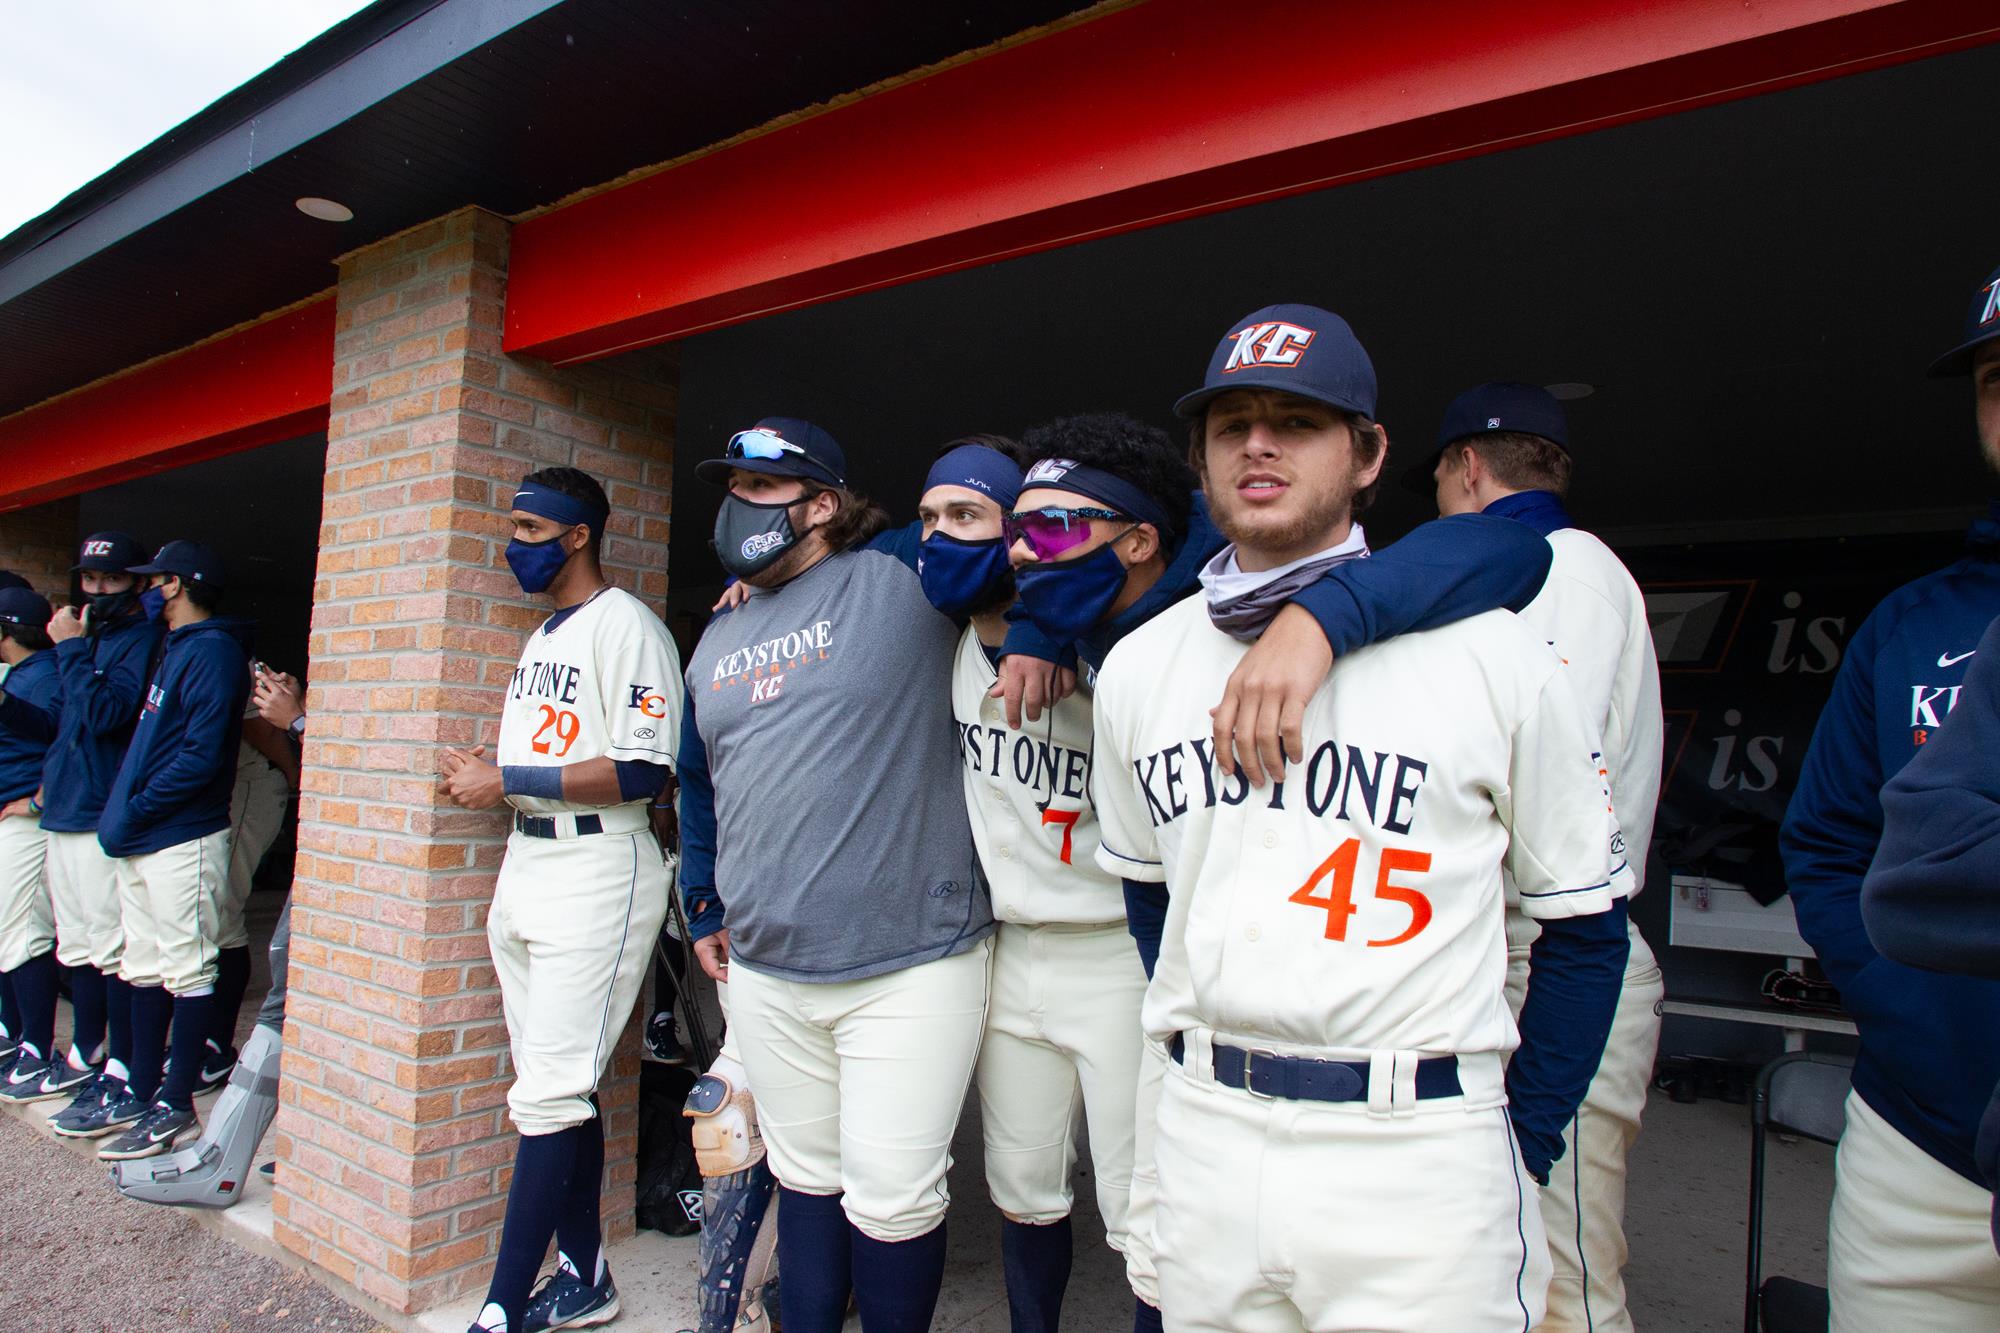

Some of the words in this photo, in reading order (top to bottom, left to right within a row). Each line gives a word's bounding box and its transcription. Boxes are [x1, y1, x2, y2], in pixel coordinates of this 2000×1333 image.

[1222, 321, 1317, 373] KC
[83, 541, 114, 556] KC
[712, 621, 832, 681] KEYSTONE
[1766, 591, 1846, 674] is
[628, 685, 666, 719] KC
[750, 673, 785, 703] KC
[531, 704, 581, 758] 29
[1707, 709, 1784, 791] is
[1042, 808, 1081, 865] 7
[1287, 837, 1433, 947] 45
